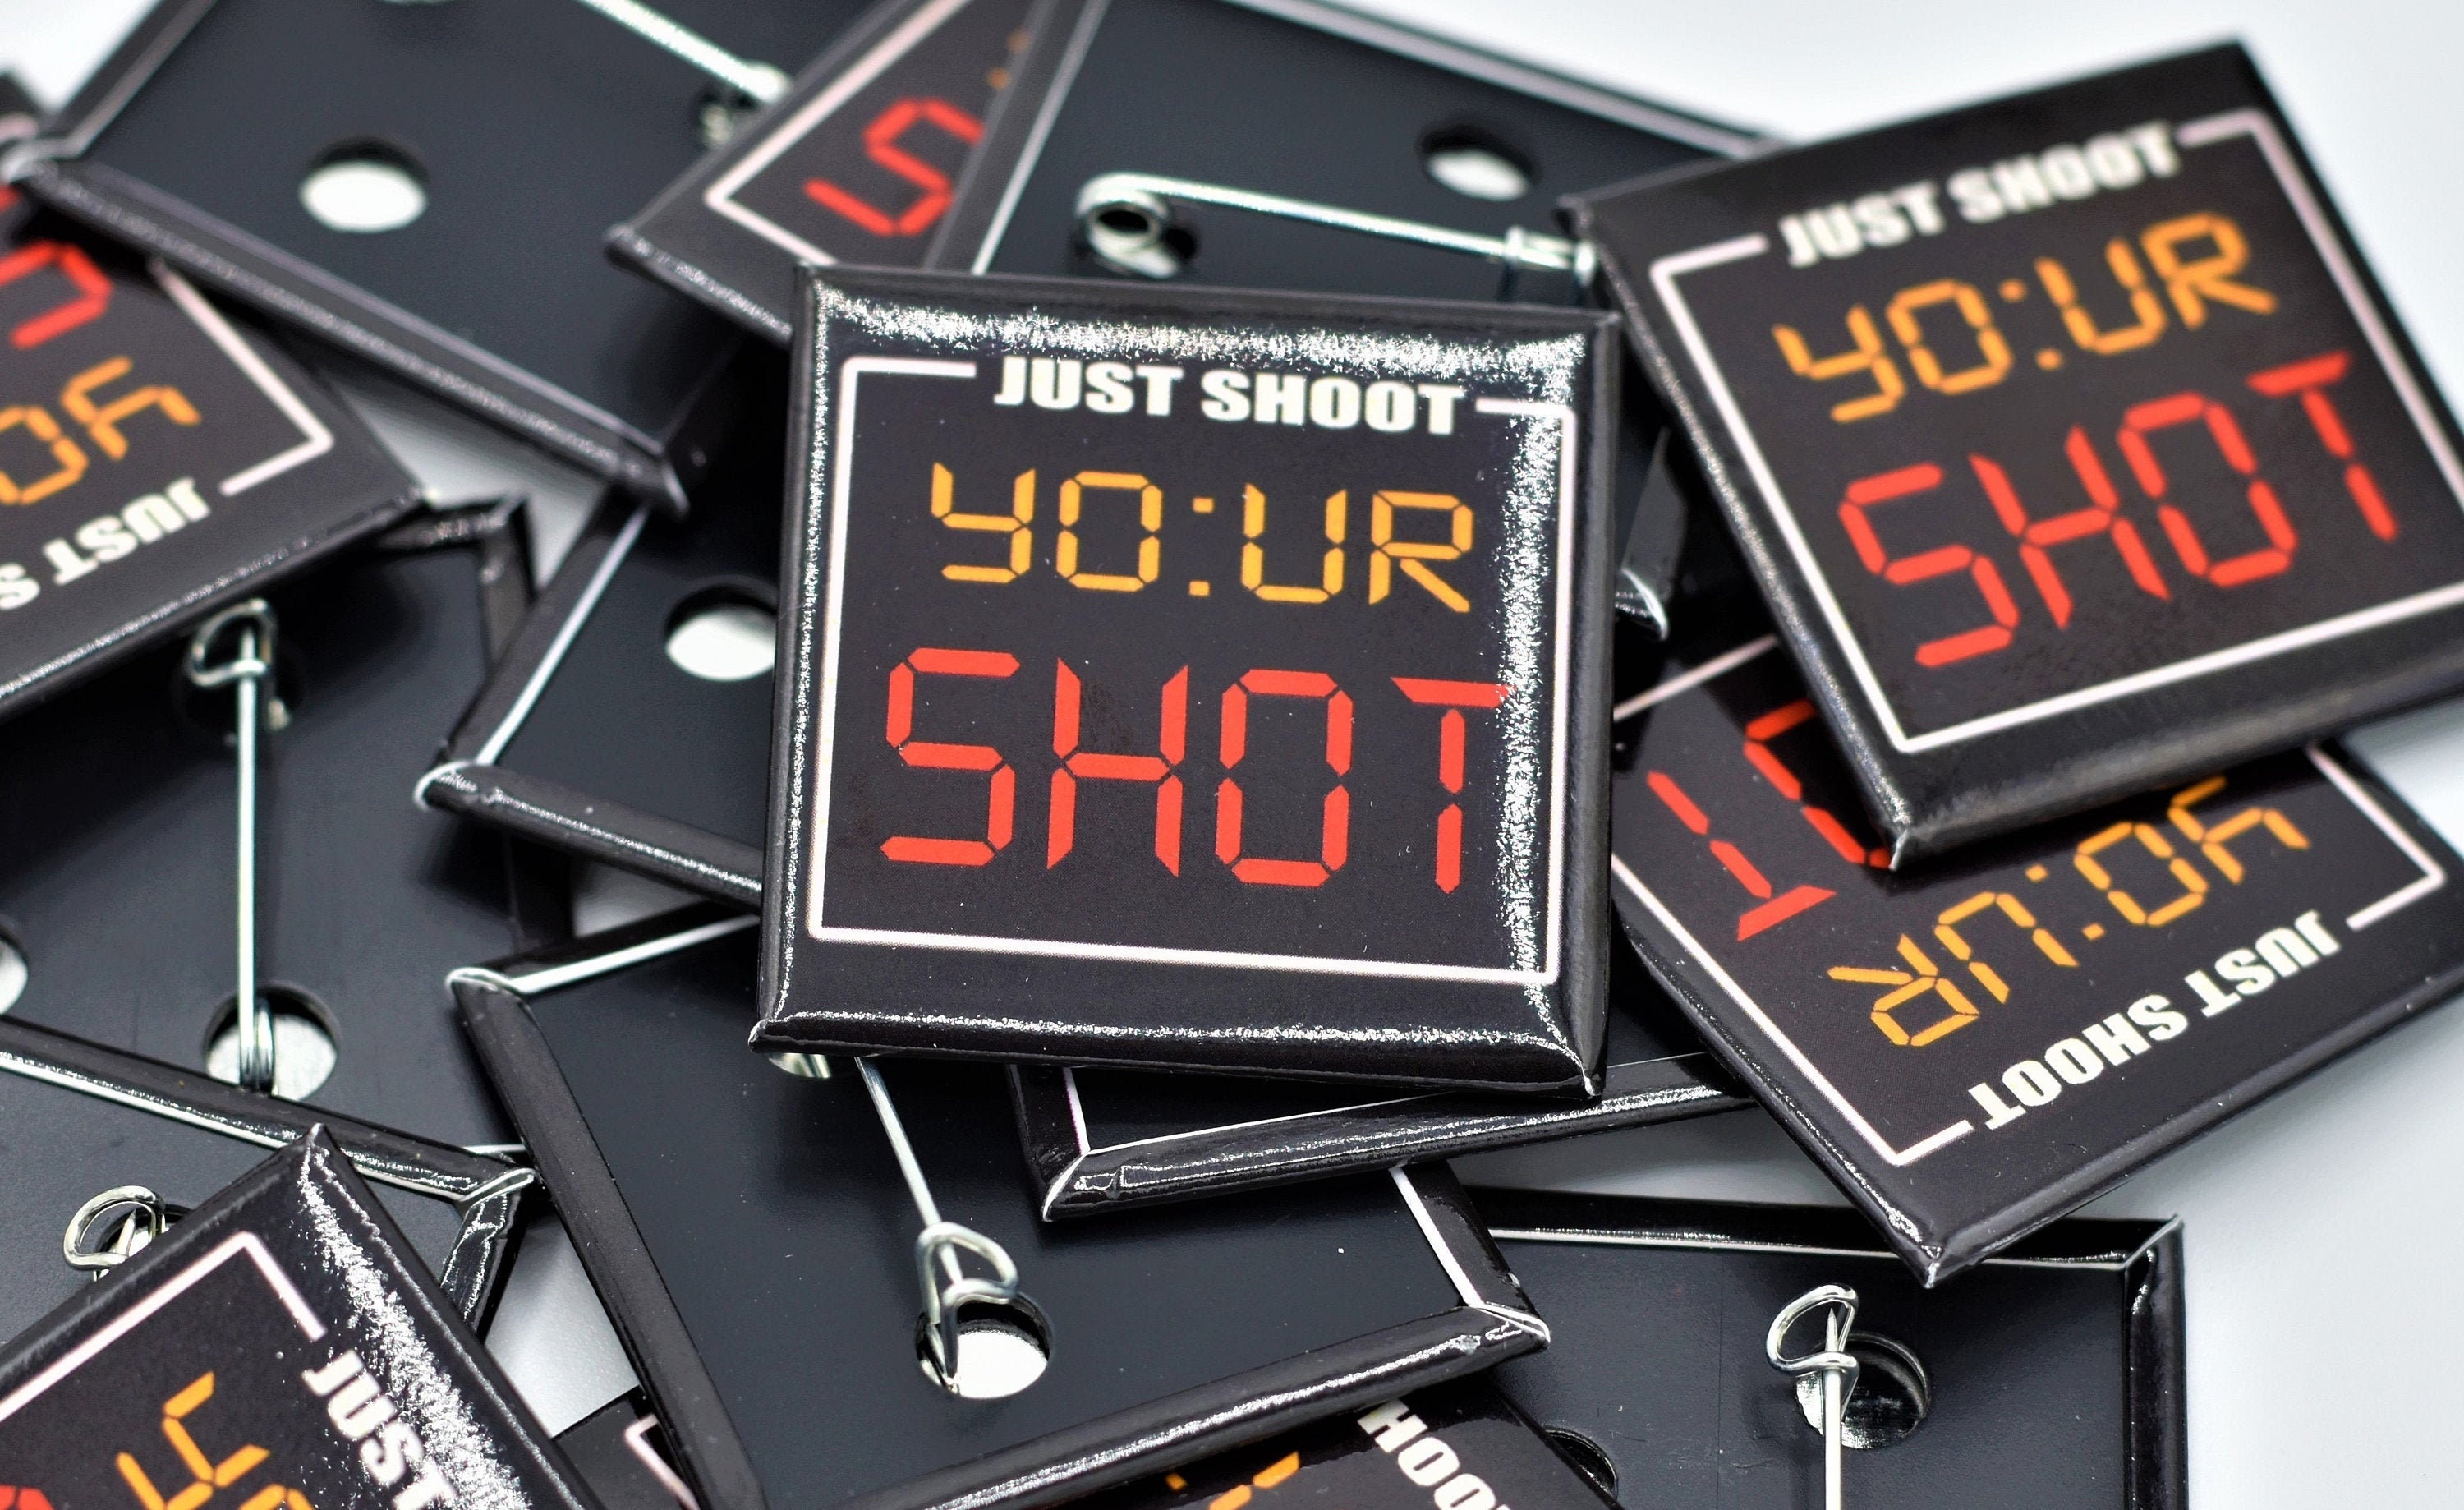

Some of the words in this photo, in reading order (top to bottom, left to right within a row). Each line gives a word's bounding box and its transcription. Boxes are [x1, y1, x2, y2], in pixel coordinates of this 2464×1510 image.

[1780, 182, 1944, 266] JUST
[1947, 123, 2179, 222] SHOOT
[1772, 211, 2278, 423] YO:UR
[993, 355, 1184, 414] JUST
[1201, 369, 1465, 435] SHOOT
[43, 477, 210, 586] JUST
[930, 462, 1474, 614] YO:UR
[1837, 350, 2399, 668] SHOT
[880, 647, 1512, 895] SHOT
[1827, 776, 2310, 1047] YO:UR
[2184, 909, 2341, 1018] JUST
[1968, 994, 2190, 1130] SHOOT
[301, 1348, 460, 1510] JUST
[1357, 1400, 1511, 1510] HOO
